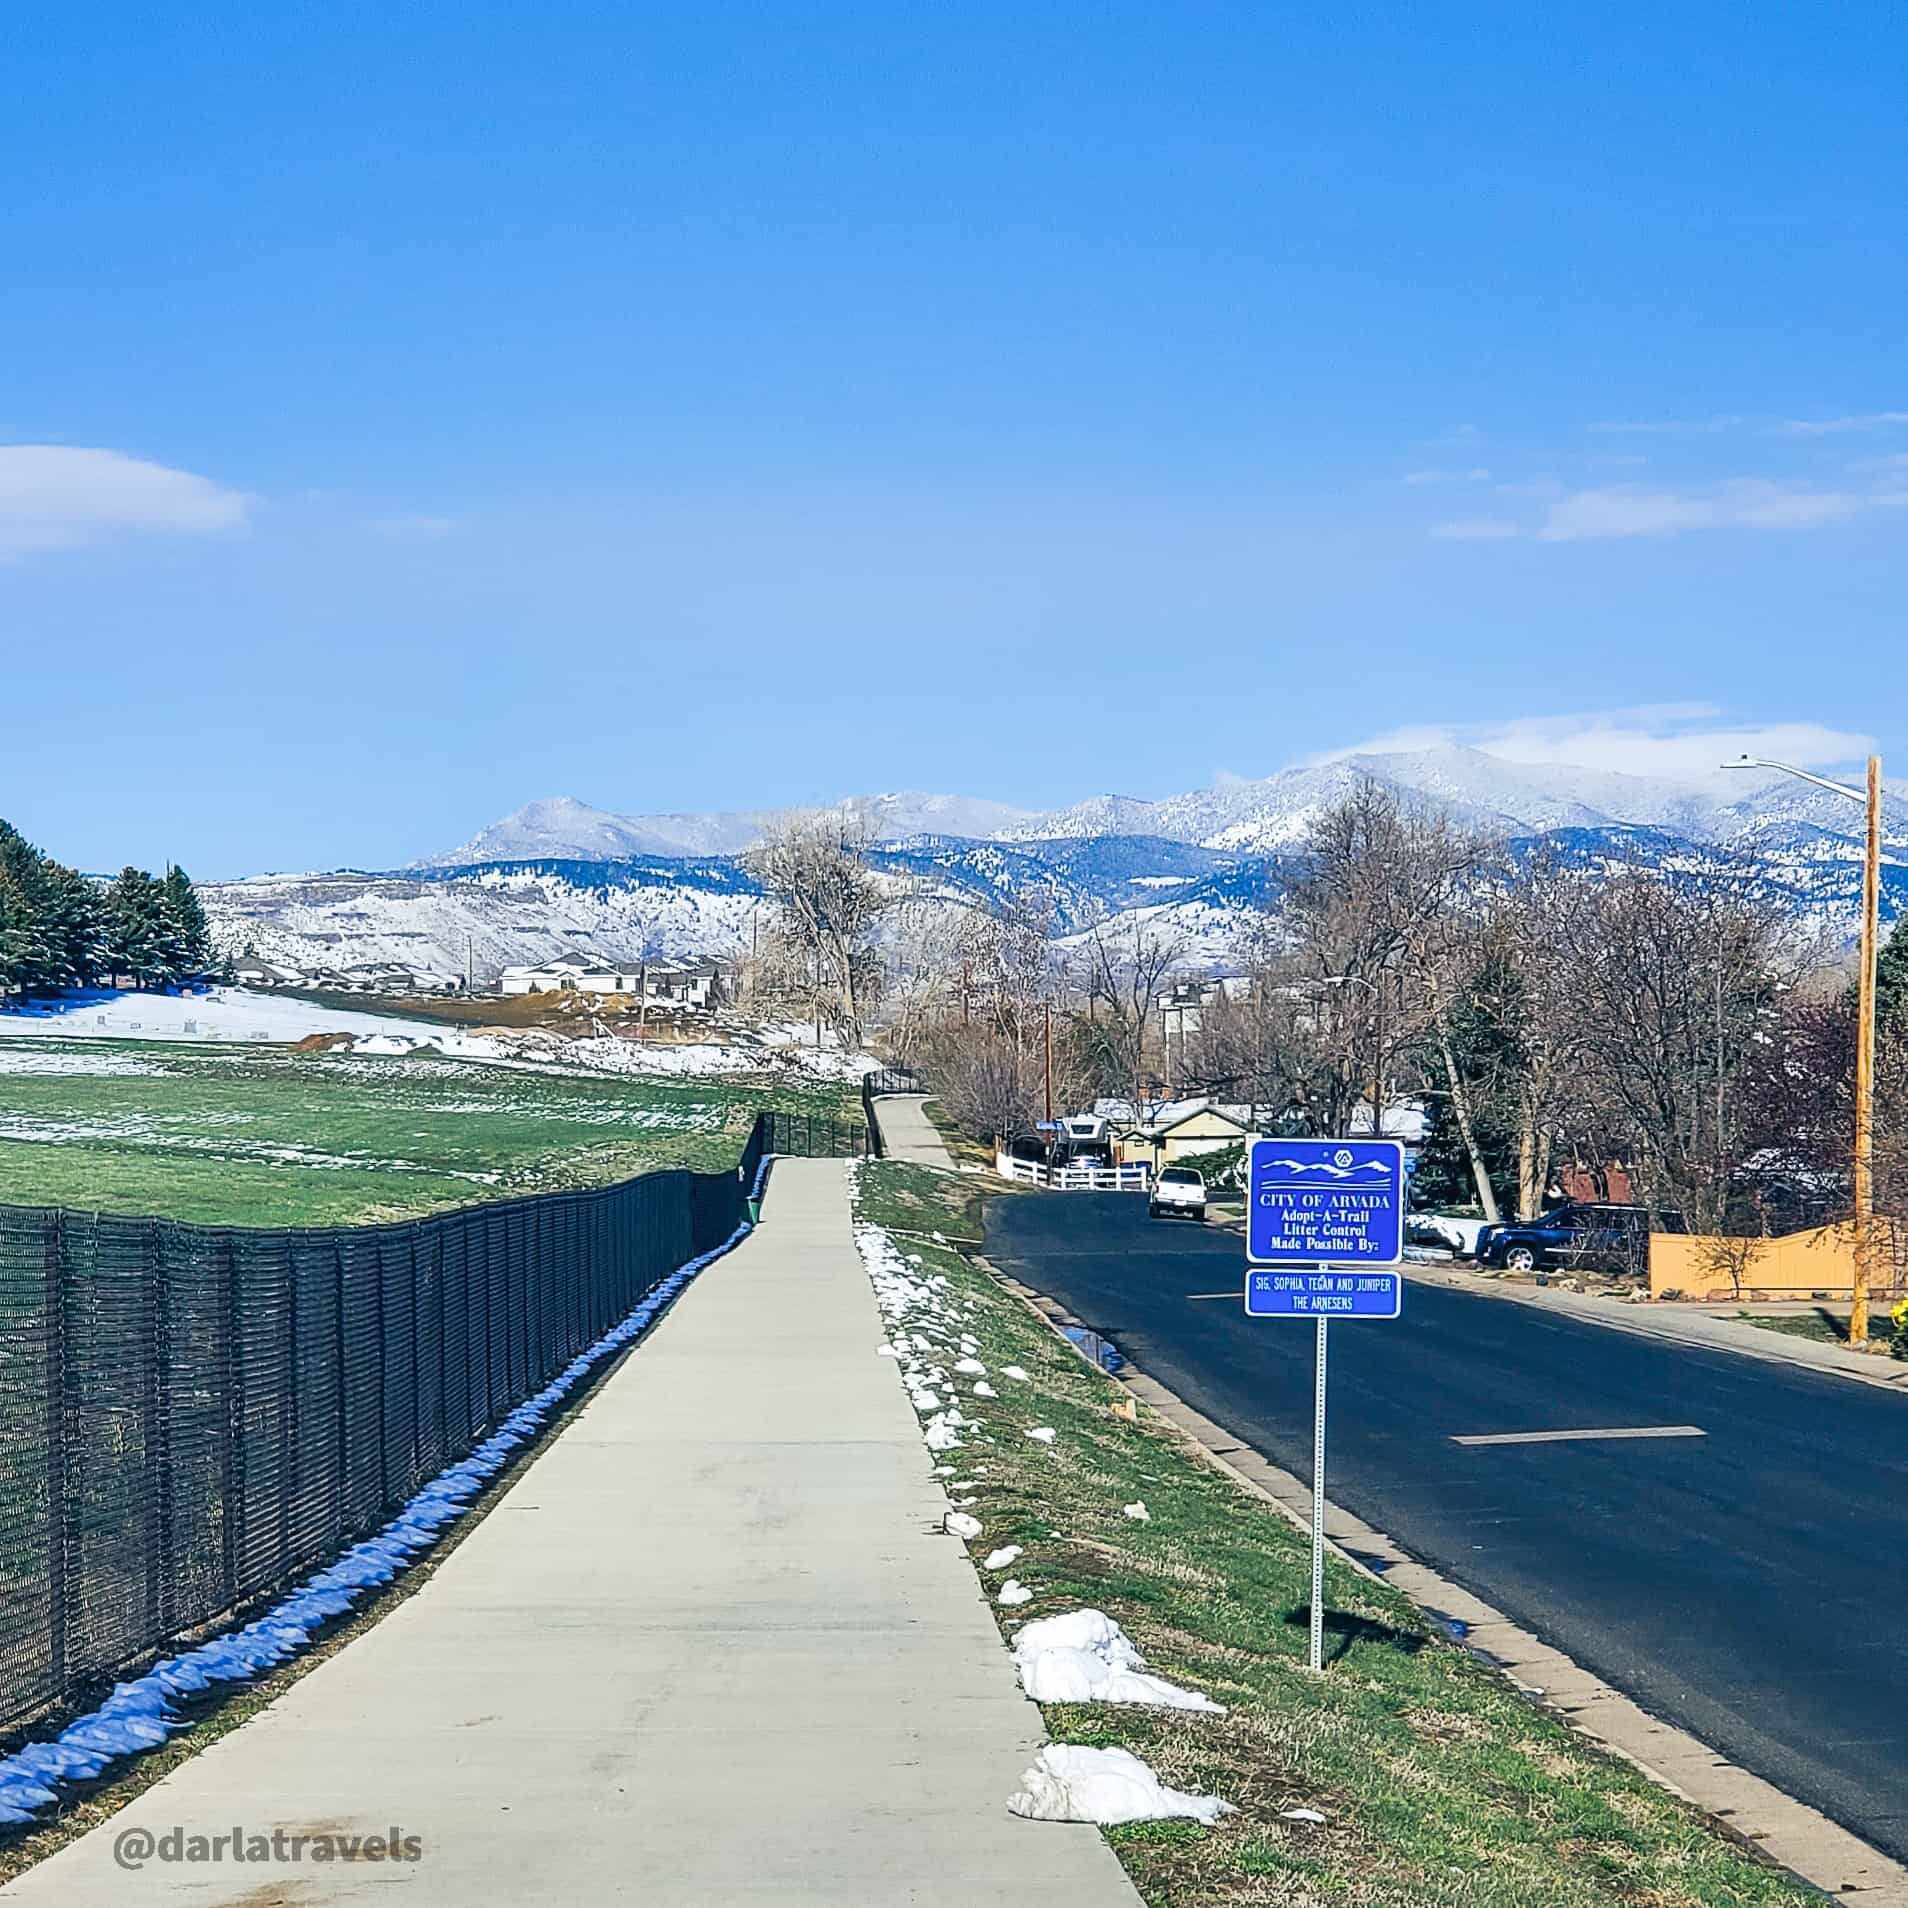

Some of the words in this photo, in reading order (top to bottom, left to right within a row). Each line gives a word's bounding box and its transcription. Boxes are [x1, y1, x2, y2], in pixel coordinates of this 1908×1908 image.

[1260, 1193, 1296, 1208] CITY
[1302, 1195, 1324, 1208] OF
[1328, 1195, 1390, 1209] ARVADA
[1281, 1209, 1370, 1224] Adopt-A-Trail
[1283, 1223, 1319, 1236] Litter
[1323, 1224, 1366, 1237] Control
[1271, 1237, 1301, 1250] Made
[1306, 1238, 1354, 1251] Possible
[1358, 1238, 1379, 1254] By:
[1308, 1278, 1334, 1291] TEGAN
[1336, 1278, 1353, 1292] AND
[1356, 1279, 1391, 1292] JUNIPER
[1293, 1296, 1308, 1310] THE
